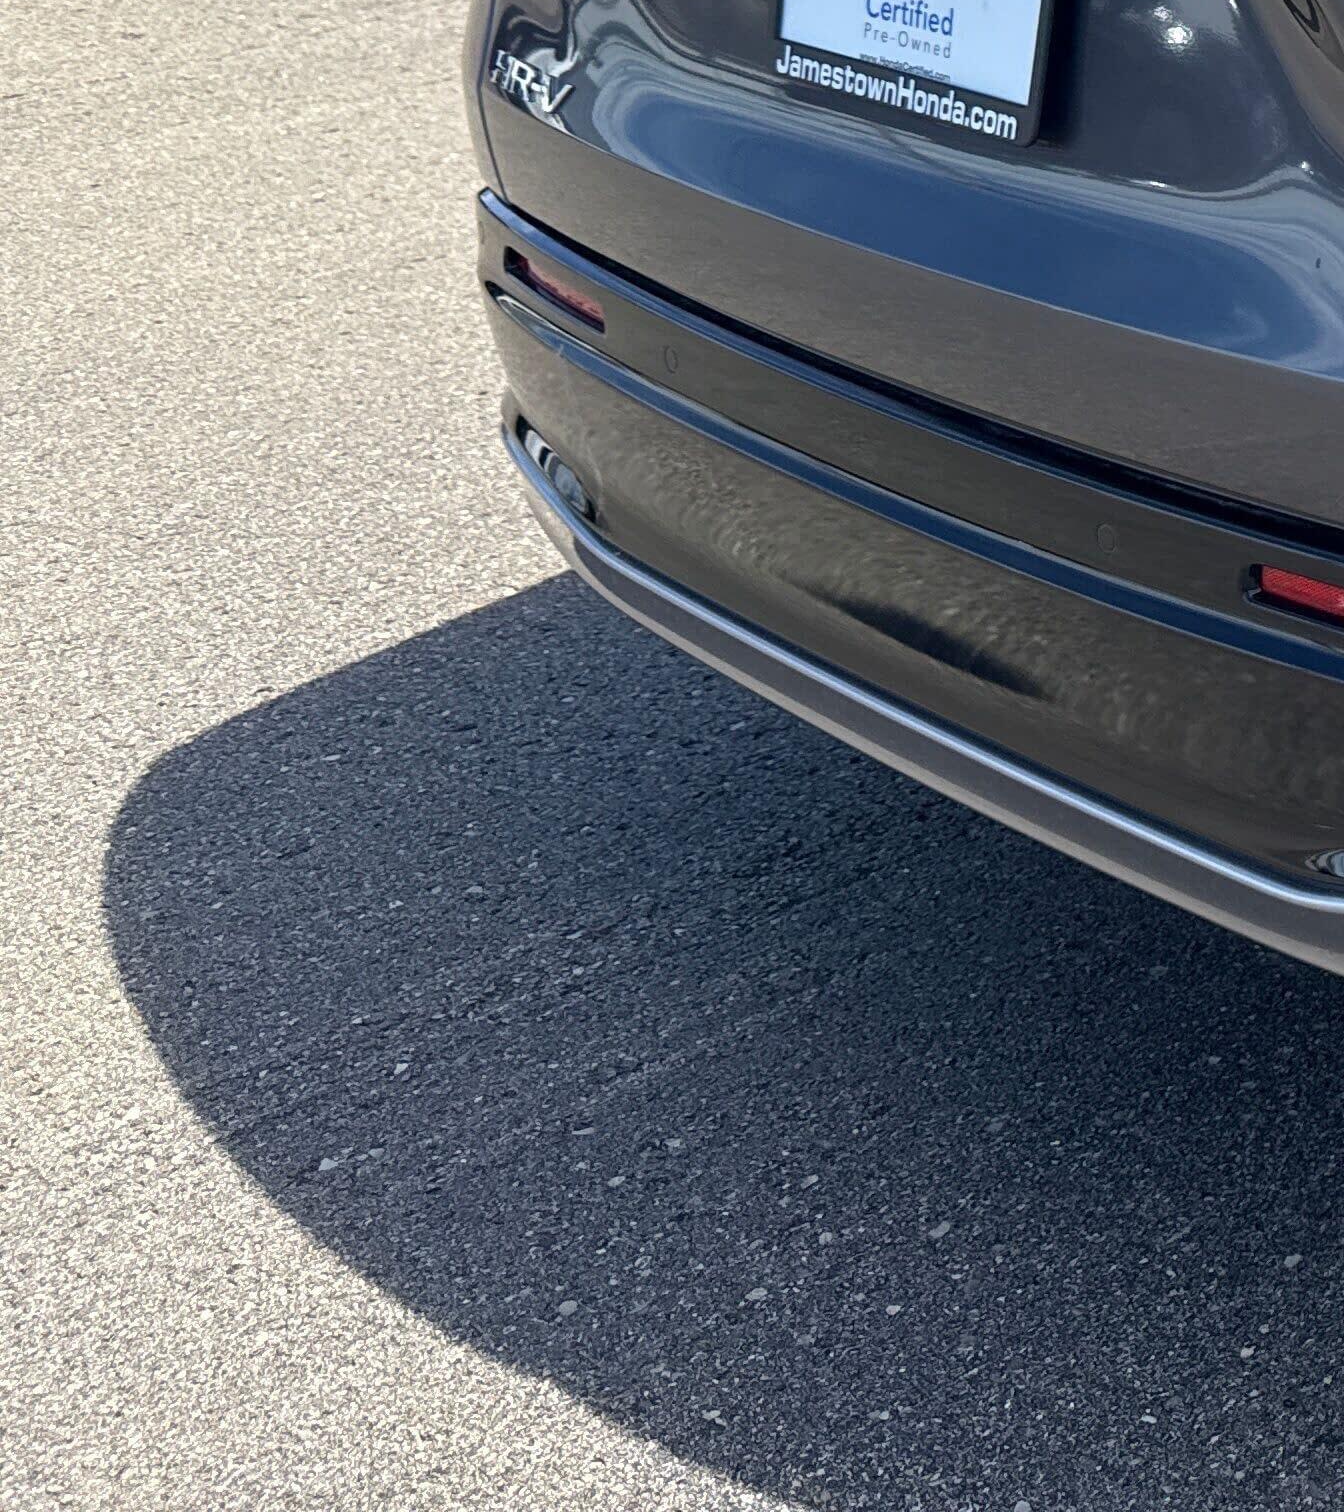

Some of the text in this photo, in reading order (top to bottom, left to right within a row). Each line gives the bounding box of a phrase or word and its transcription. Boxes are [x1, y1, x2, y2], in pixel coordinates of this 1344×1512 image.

[863, 21, 952, 59] Pre-Owned
[489, 48, 575, 113] HR-V
[776, 44, 1018, 141] JamestownHonda.com
